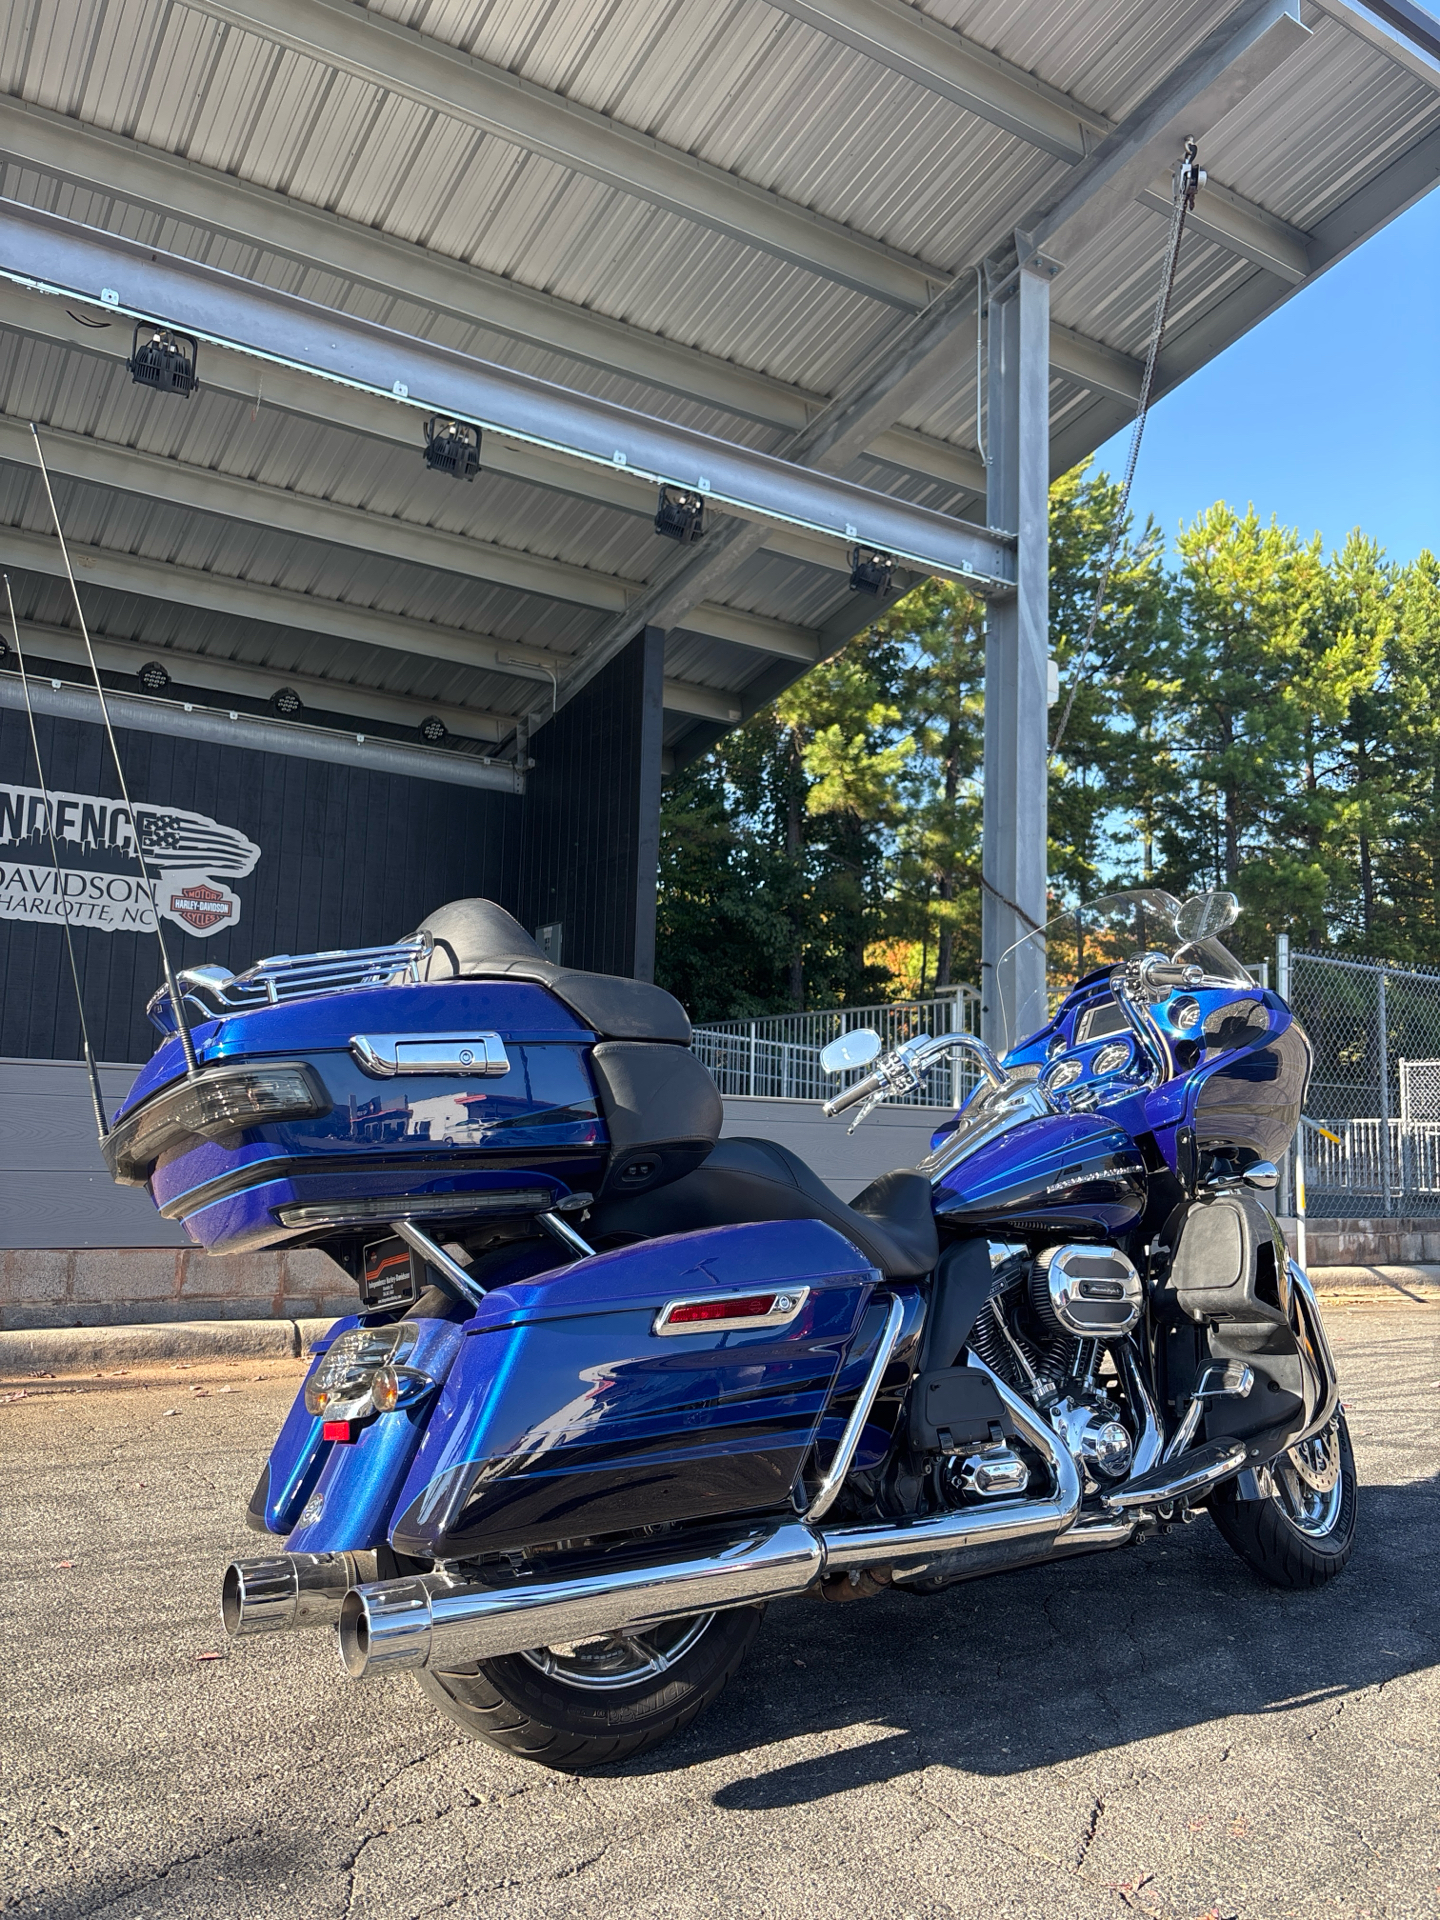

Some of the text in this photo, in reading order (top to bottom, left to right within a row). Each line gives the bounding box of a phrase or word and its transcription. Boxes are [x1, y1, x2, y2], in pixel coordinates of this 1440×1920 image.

[189, 889, 217, 900] MOTOR
[175, 899, 229, 914] HARLEY-DAVIDSON
[121, 907, 154, 925] NC
[187, 912, 216, 925] CYCLES
[1339, 1473, 1353, 1532] MICHELIN
[635, 1633, 730, 1715] MICHELIN
